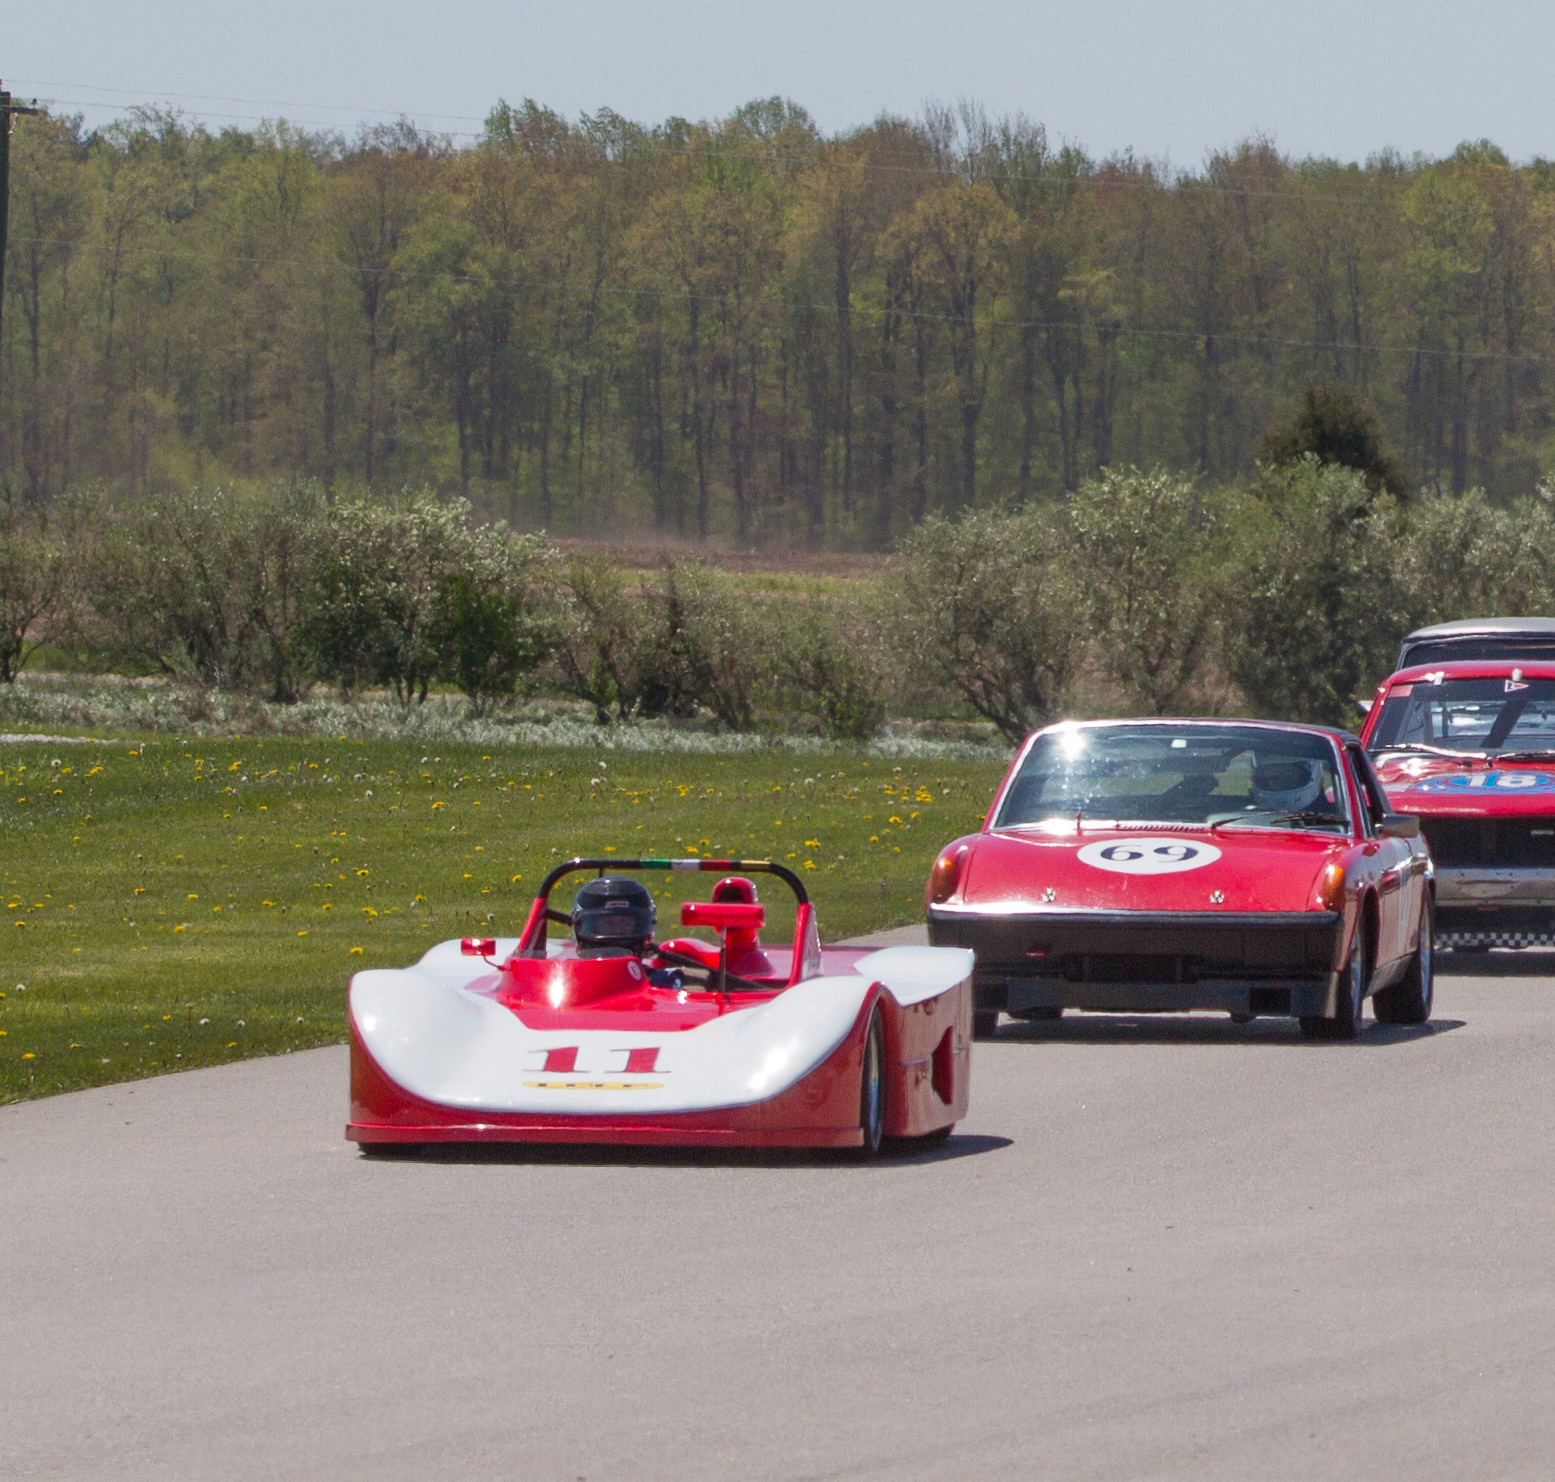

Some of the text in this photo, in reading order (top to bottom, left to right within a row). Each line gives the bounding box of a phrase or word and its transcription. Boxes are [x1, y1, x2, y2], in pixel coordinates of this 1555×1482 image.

[1468, 773, 1539, 788] 18
[1100, 844, 1200, 864] 69
[523, 1045, 672, 1074] 11
